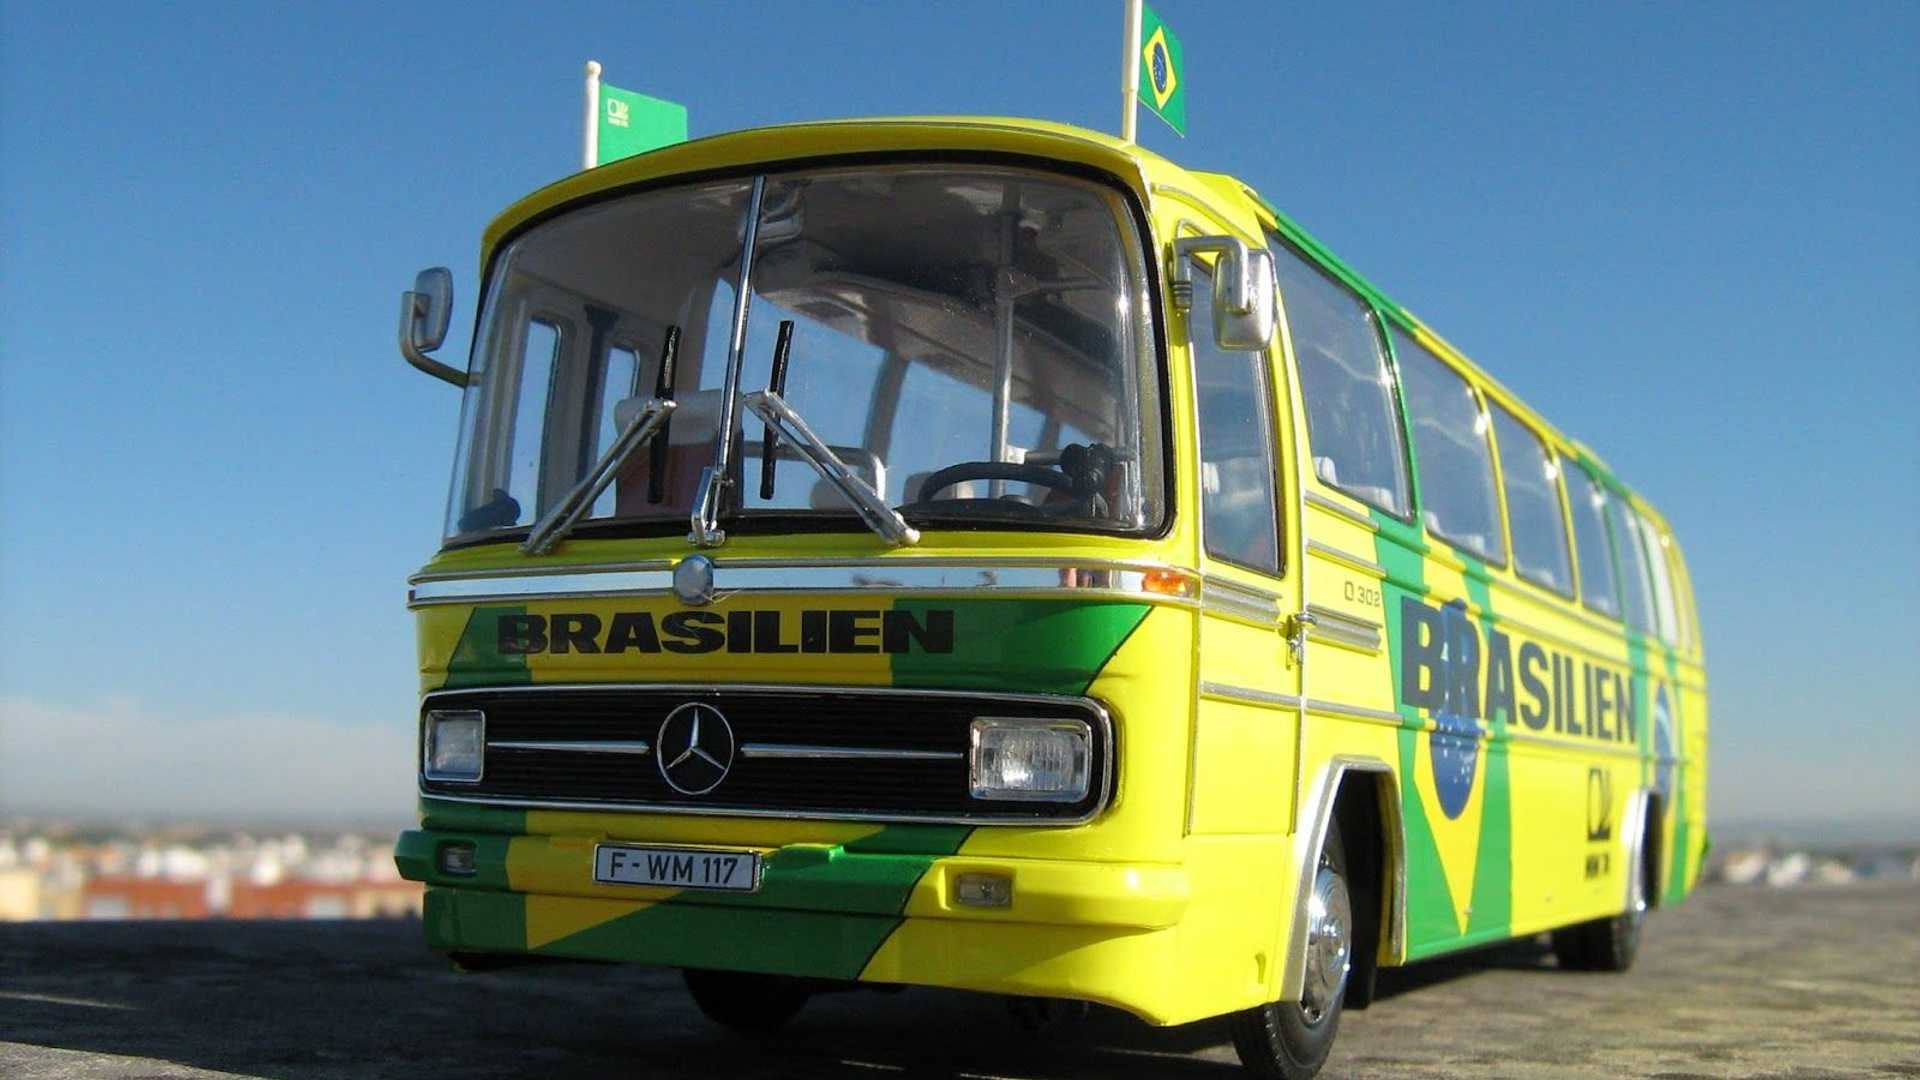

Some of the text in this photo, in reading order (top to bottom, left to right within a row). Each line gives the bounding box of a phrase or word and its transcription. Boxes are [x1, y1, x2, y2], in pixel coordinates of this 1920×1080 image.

[1358, 586, 1380, 607] 302
[496, 610, 954, 654] BRASILIEN
[1401, 596, 1635, 743] BRASILIEN
[703, 856, 739, 885] 117
